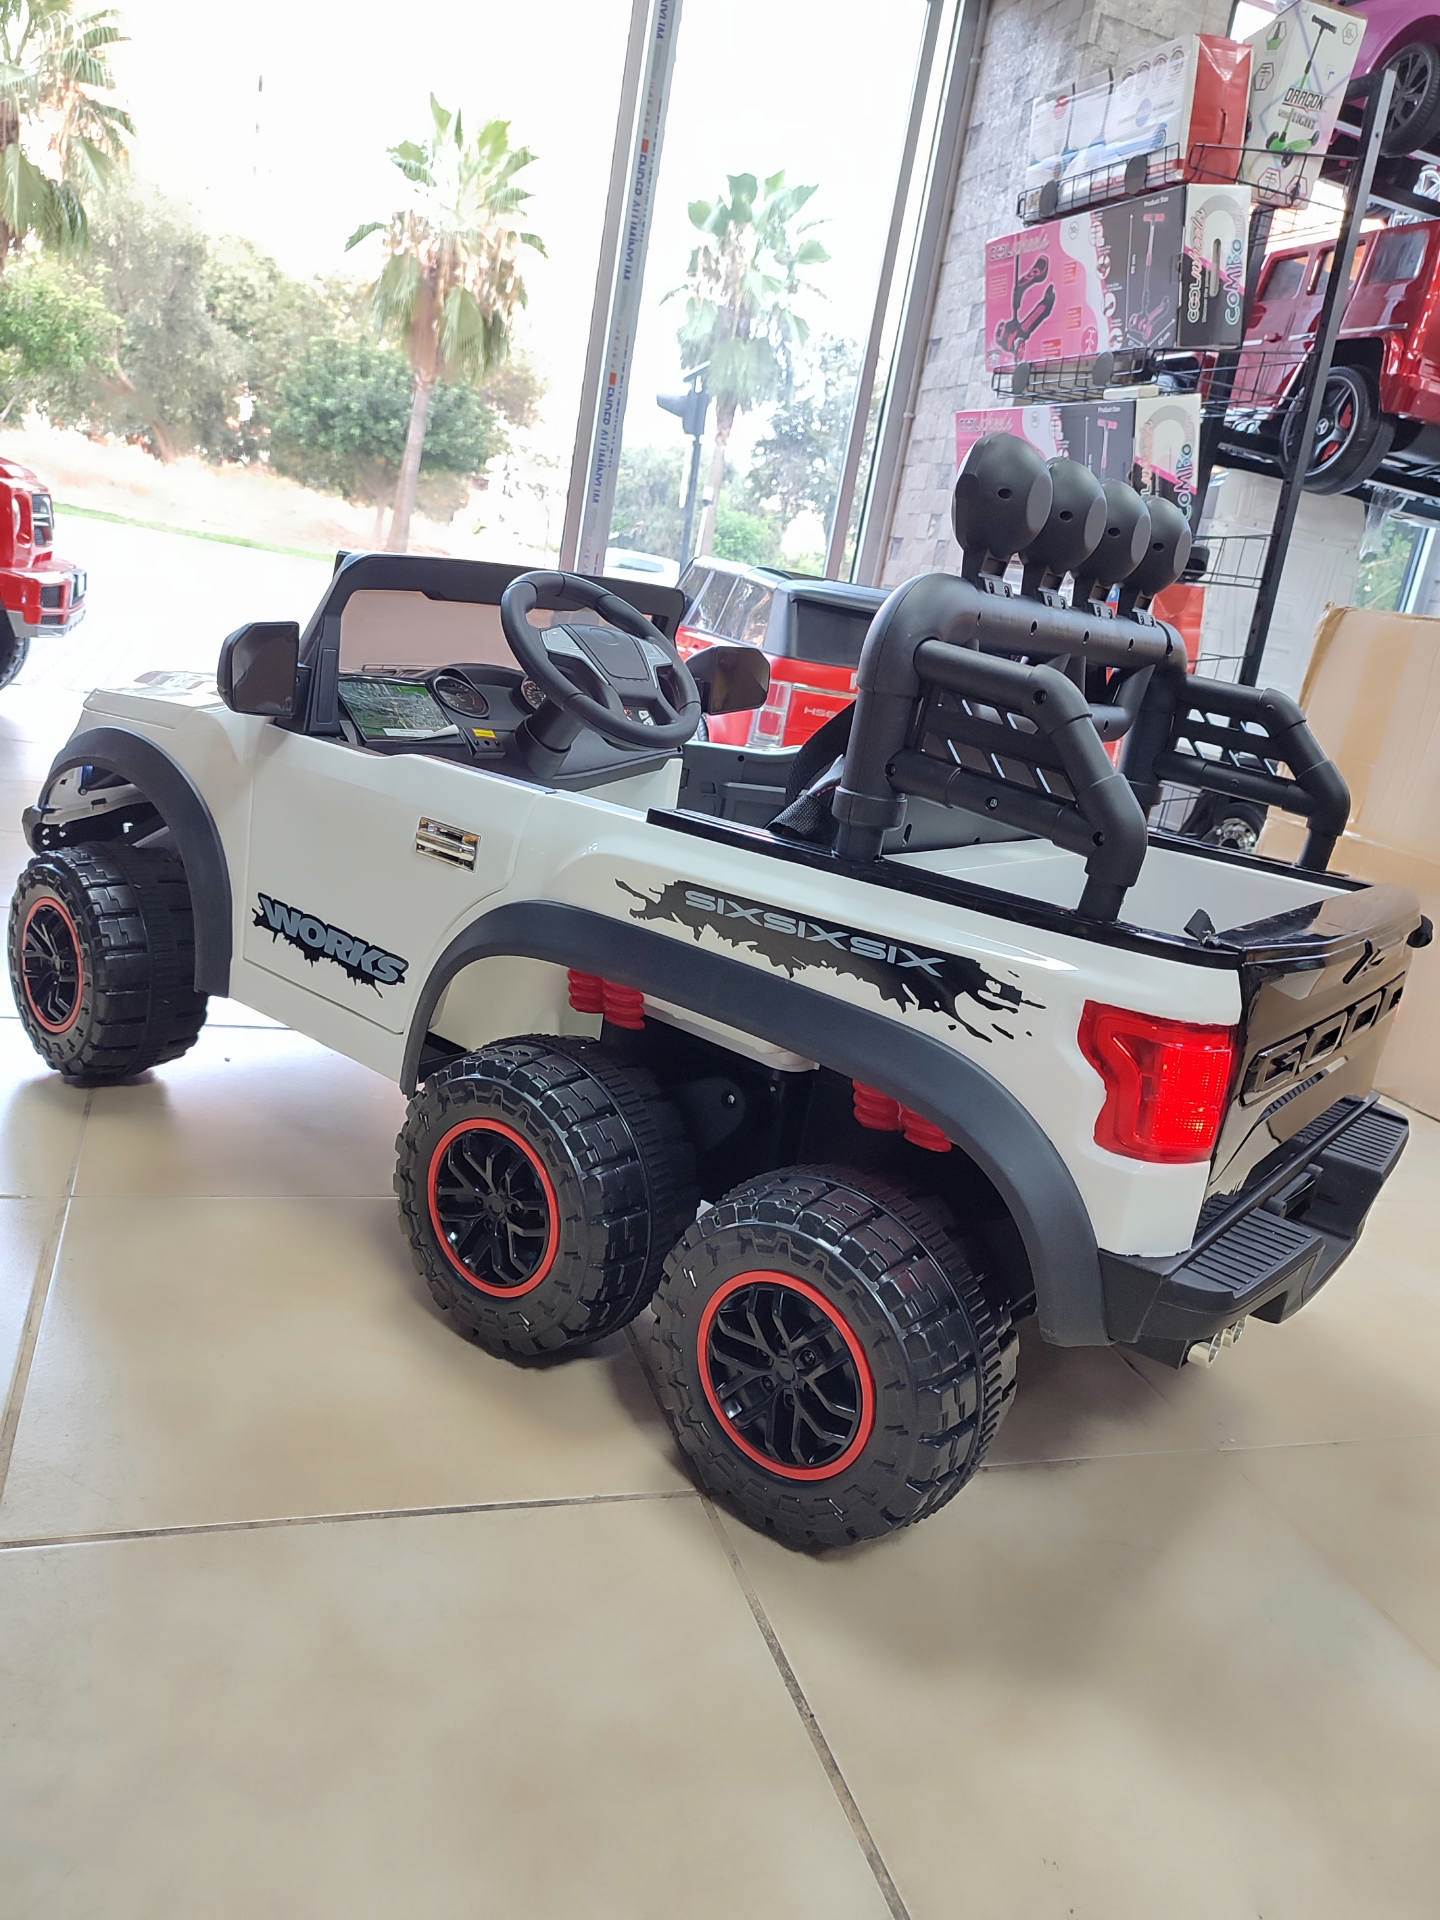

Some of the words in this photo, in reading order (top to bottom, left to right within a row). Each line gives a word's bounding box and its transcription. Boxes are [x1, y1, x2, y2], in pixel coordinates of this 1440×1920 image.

[1283, 87, 1328, 111] DRAGON
[258, 894, 409, 983] WORKS
[684, 889, 947, 979] SIXSIXSIX
